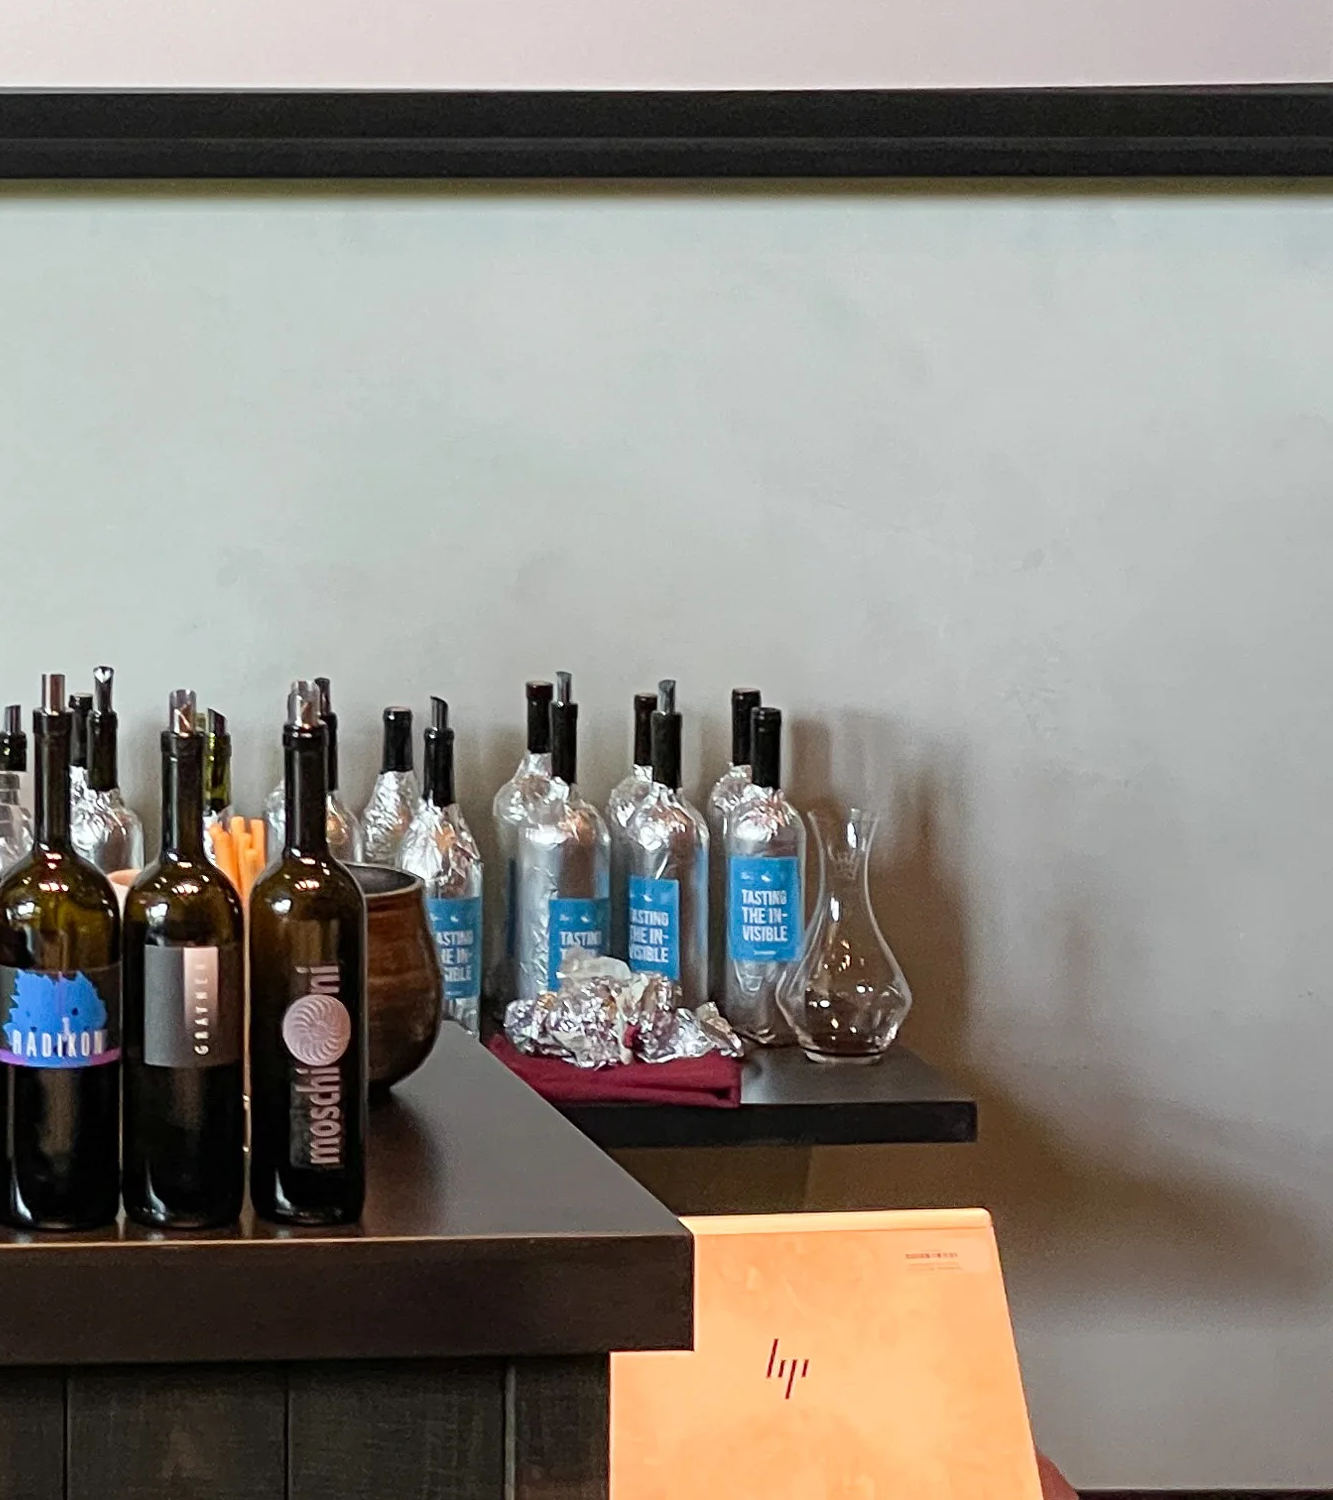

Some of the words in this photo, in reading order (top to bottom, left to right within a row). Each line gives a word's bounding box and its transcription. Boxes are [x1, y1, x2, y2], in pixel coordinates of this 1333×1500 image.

[741, 890, 788, 906] TASTING
[741, 907, 767, 925] THE
[742, 926, 789, 942] VISIBLE
[12, 1029, 106, 1058] RADIKON
[766, 1338, 810, 1400] hp
